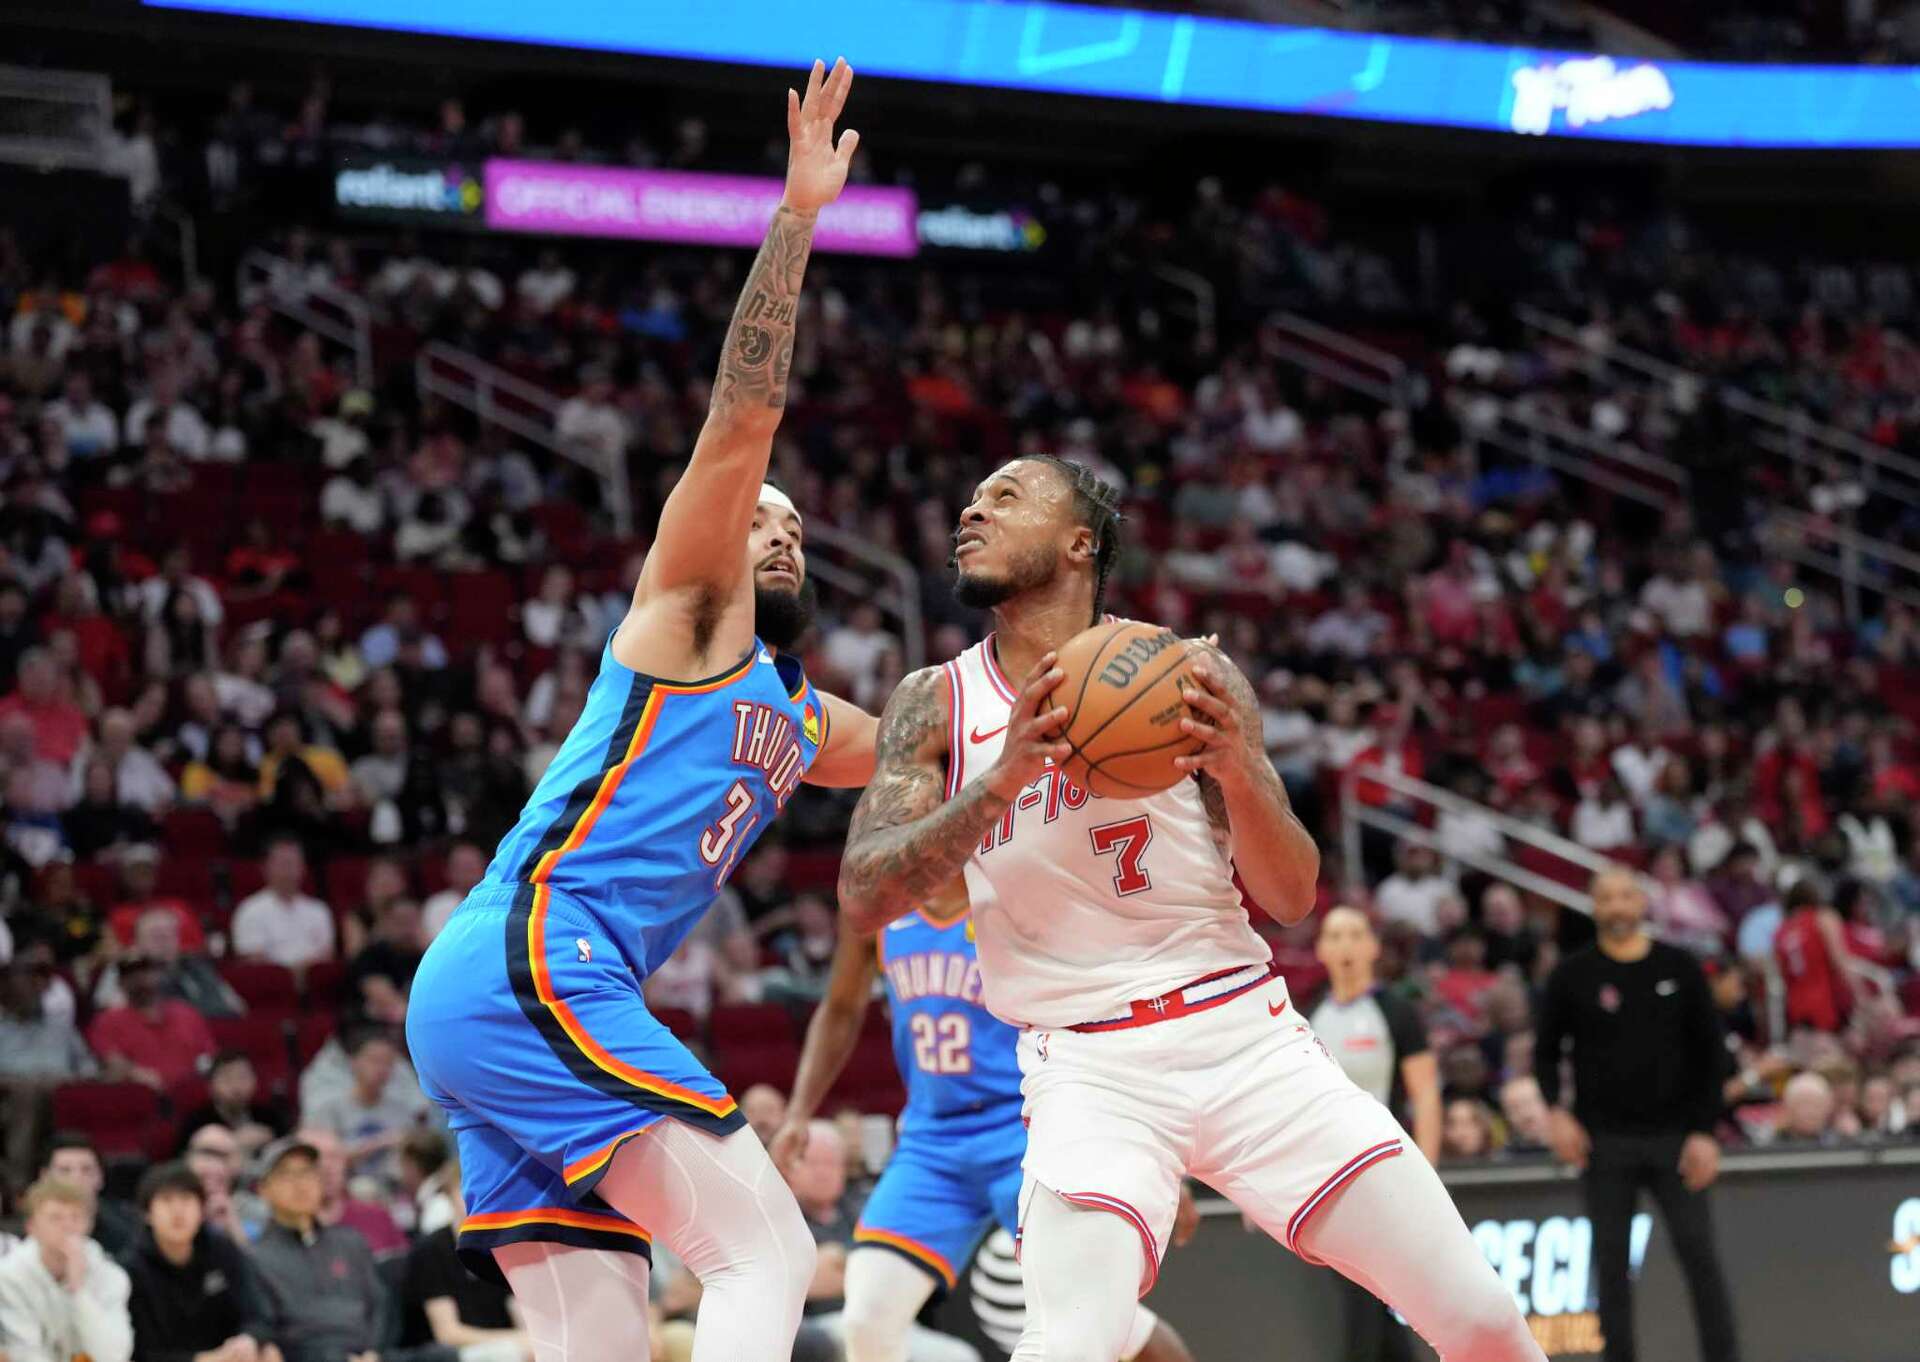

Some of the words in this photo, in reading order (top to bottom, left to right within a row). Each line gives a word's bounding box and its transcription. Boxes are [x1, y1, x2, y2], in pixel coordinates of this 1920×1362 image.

[699, 778, 760, 892] 3
[1089, 813, 1153, 897] 7
[911, 1011, 973, 1076] 22
